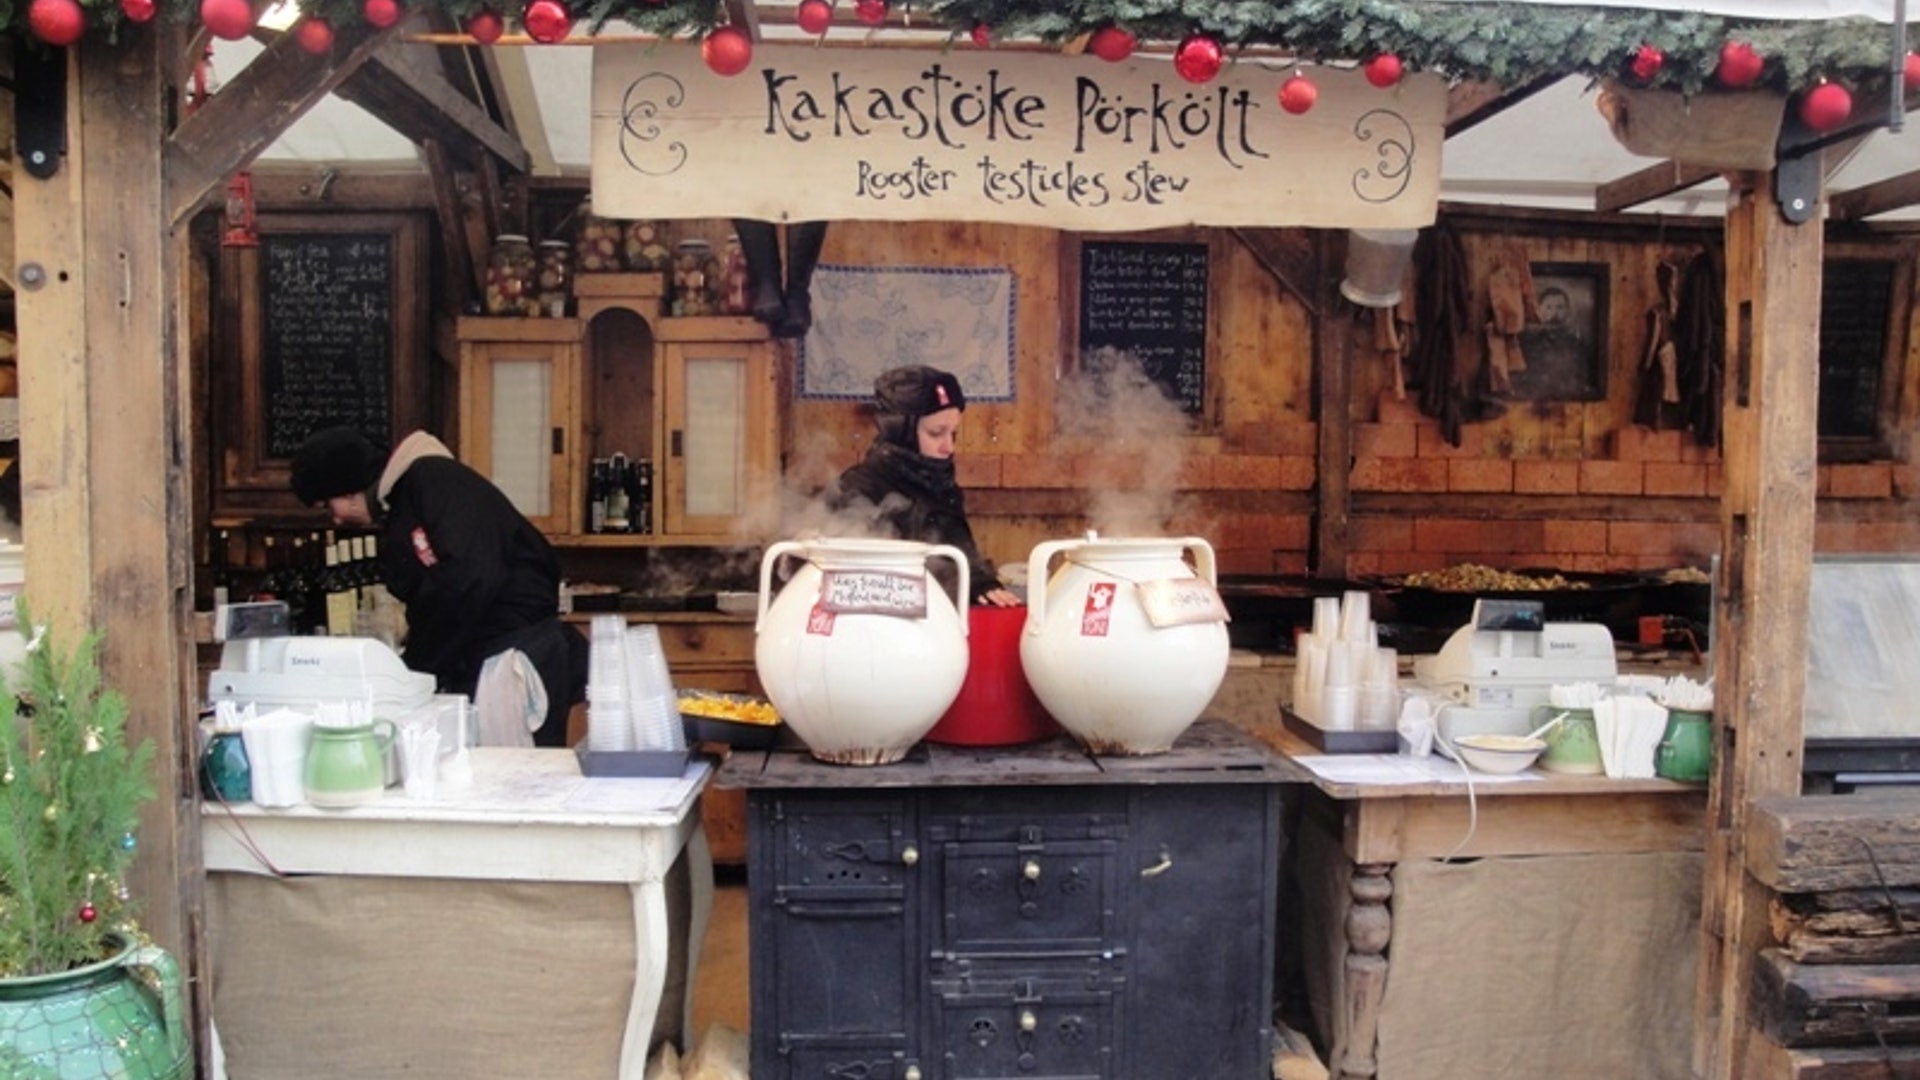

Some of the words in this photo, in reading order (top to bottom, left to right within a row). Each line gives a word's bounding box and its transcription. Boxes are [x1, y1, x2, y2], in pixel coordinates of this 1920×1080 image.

[762, 64, 1046, 149] Kakastöke
[1074, 76, 1270, 169] Pörkölt
[856, 156, 957, 200] Rooster
[976, 155, 1110, 207] testicles
[1122, 160, 1190, 204] stew
